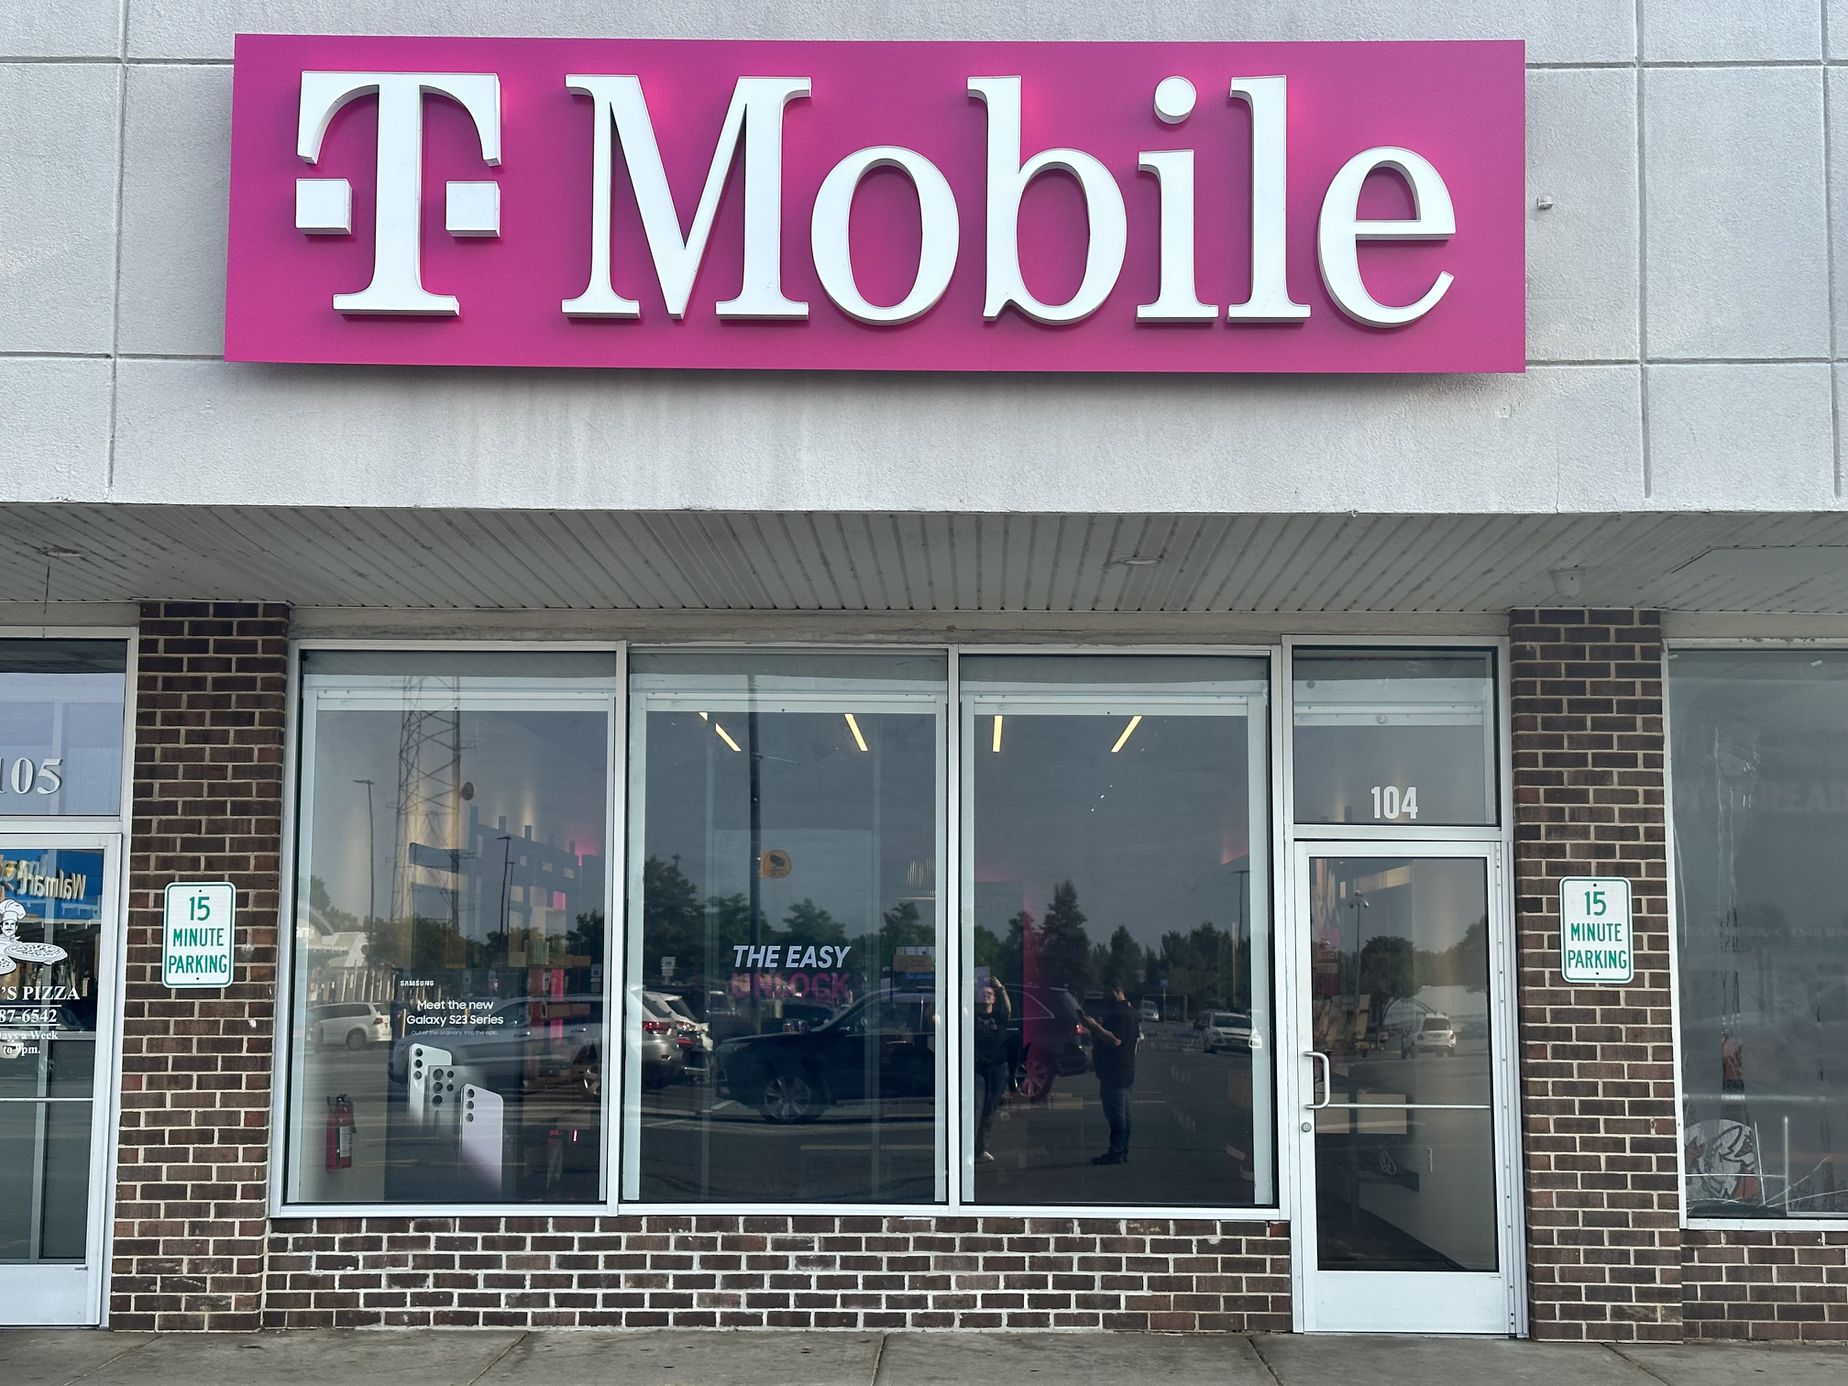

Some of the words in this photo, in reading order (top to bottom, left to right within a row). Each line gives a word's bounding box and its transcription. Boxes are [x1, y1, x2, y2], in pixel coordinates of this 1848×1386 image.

[561, 74, 1457, 328] Mobile
[0, 757, 63, 795] 05
[1371, 786, 1418, 819] 104
[189, 896, 211, 921] 15
[1585, 891, 1607, 916] 15
[173, 928, 224, 947] MINUTE
[1570, 923, 1622, 942] MINUTE
[168, 954, 227, 973] PARKING
[733, 945, 781, 968] THE
[785, 945, 851, 968] EASY
[1567, 949, 1627, 969] PARKING
[23, 986, 80, 1001] PIZZA
[417, 1000, 446, 1011] Meet
[447, 1000, 466, 1010] the
[468, 1001, 494, 1010] new
[0, 1008, 57, 1024] 87-6542
[407, 1015, 447, 1027] Galaxy
[449, 1015, 468, 1025] S23
[469, 1014, 504, 1025] Series
[30, 1031, 58, 1040] Week
